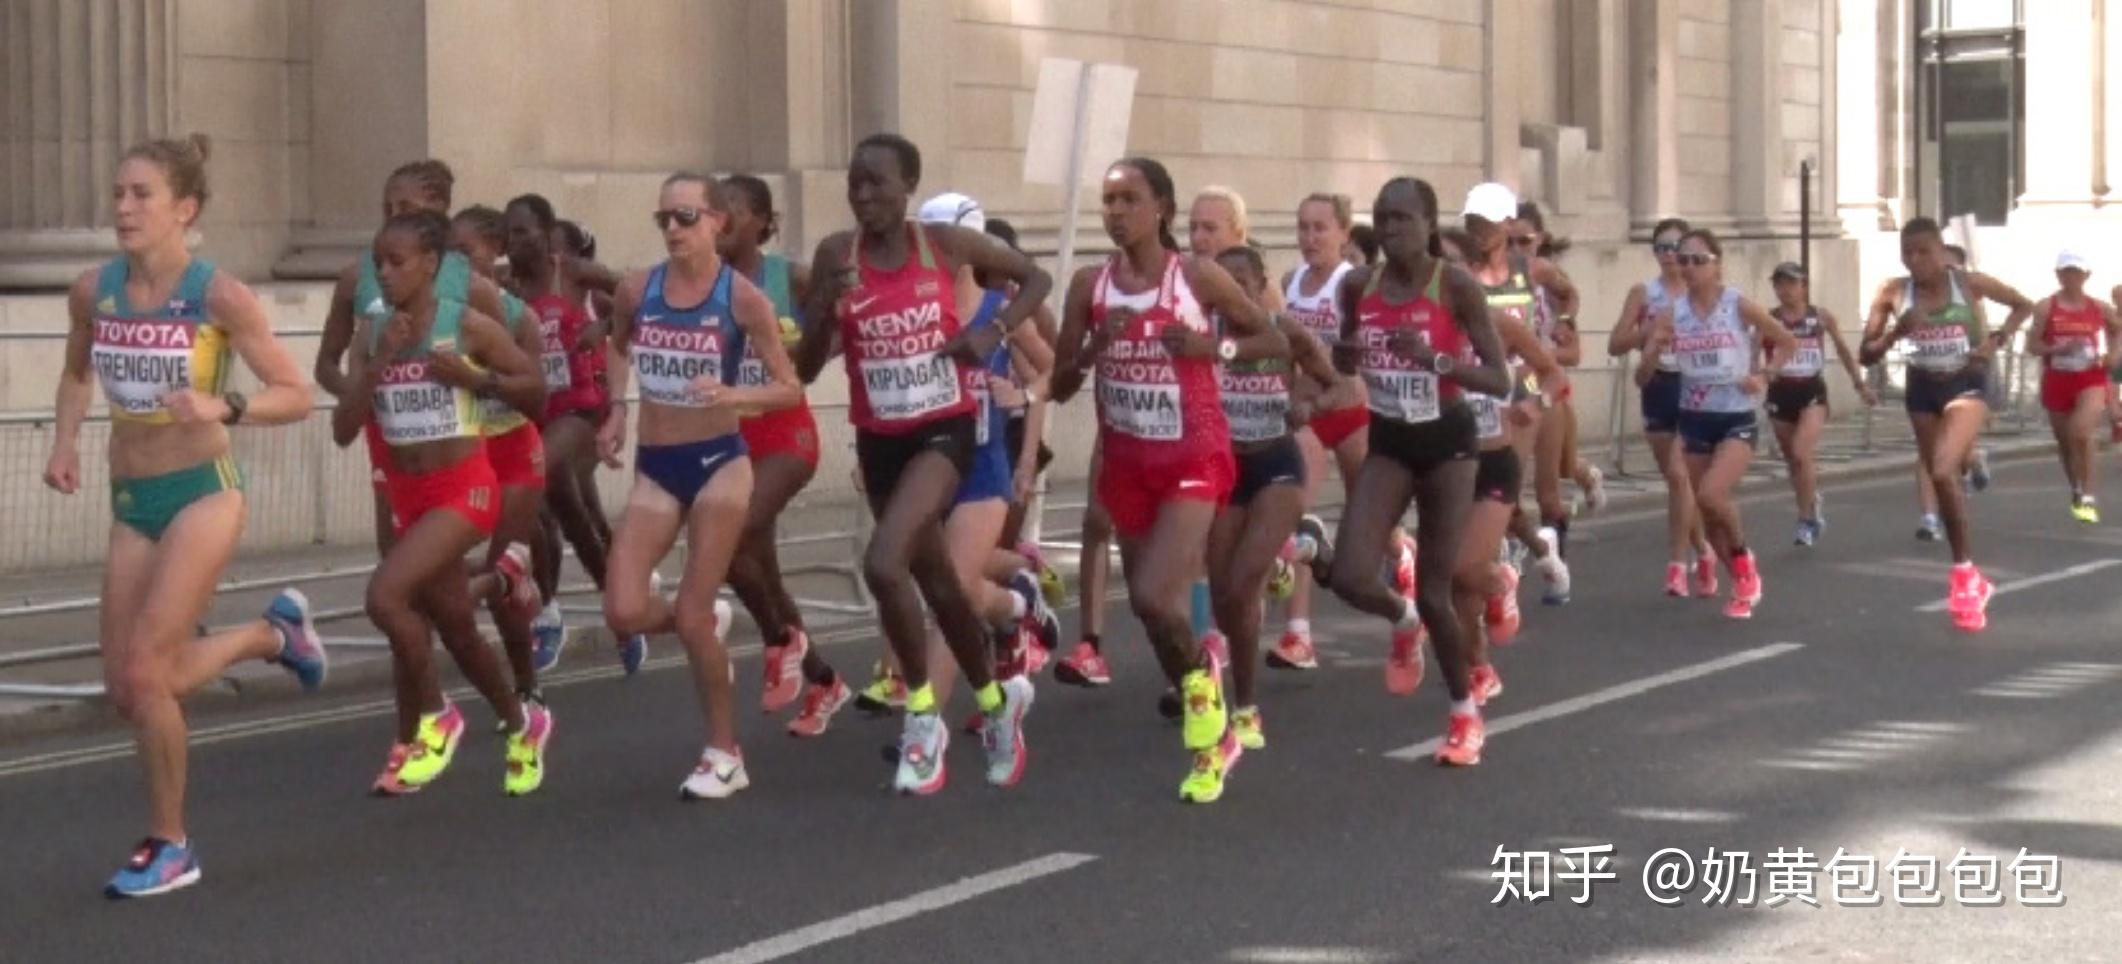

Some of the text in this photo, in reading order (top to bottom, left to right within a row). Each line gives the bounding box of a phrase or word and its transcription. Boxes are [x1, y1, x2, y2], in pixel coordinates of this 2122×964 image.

[858, 302, 941, 337] KENYA
[98, 320, 190, 346] TOYOTA
[640, 326, 719, 352] TOYOTA
[858, 329, 946, 357] TOYOTA
[1676, 334, 1733, 350] TOYOTA
[94, 351, 188, 383] TRENGOVE
[381, 362, 426, 382] OYO
[638, 353, 717, 379] CRAGG
[864, 356, 951, 392] KIPLAGAT
[1102, 362, 1176, 382] OYOTA
[1221, 375, 1286, 392] OYOTA
